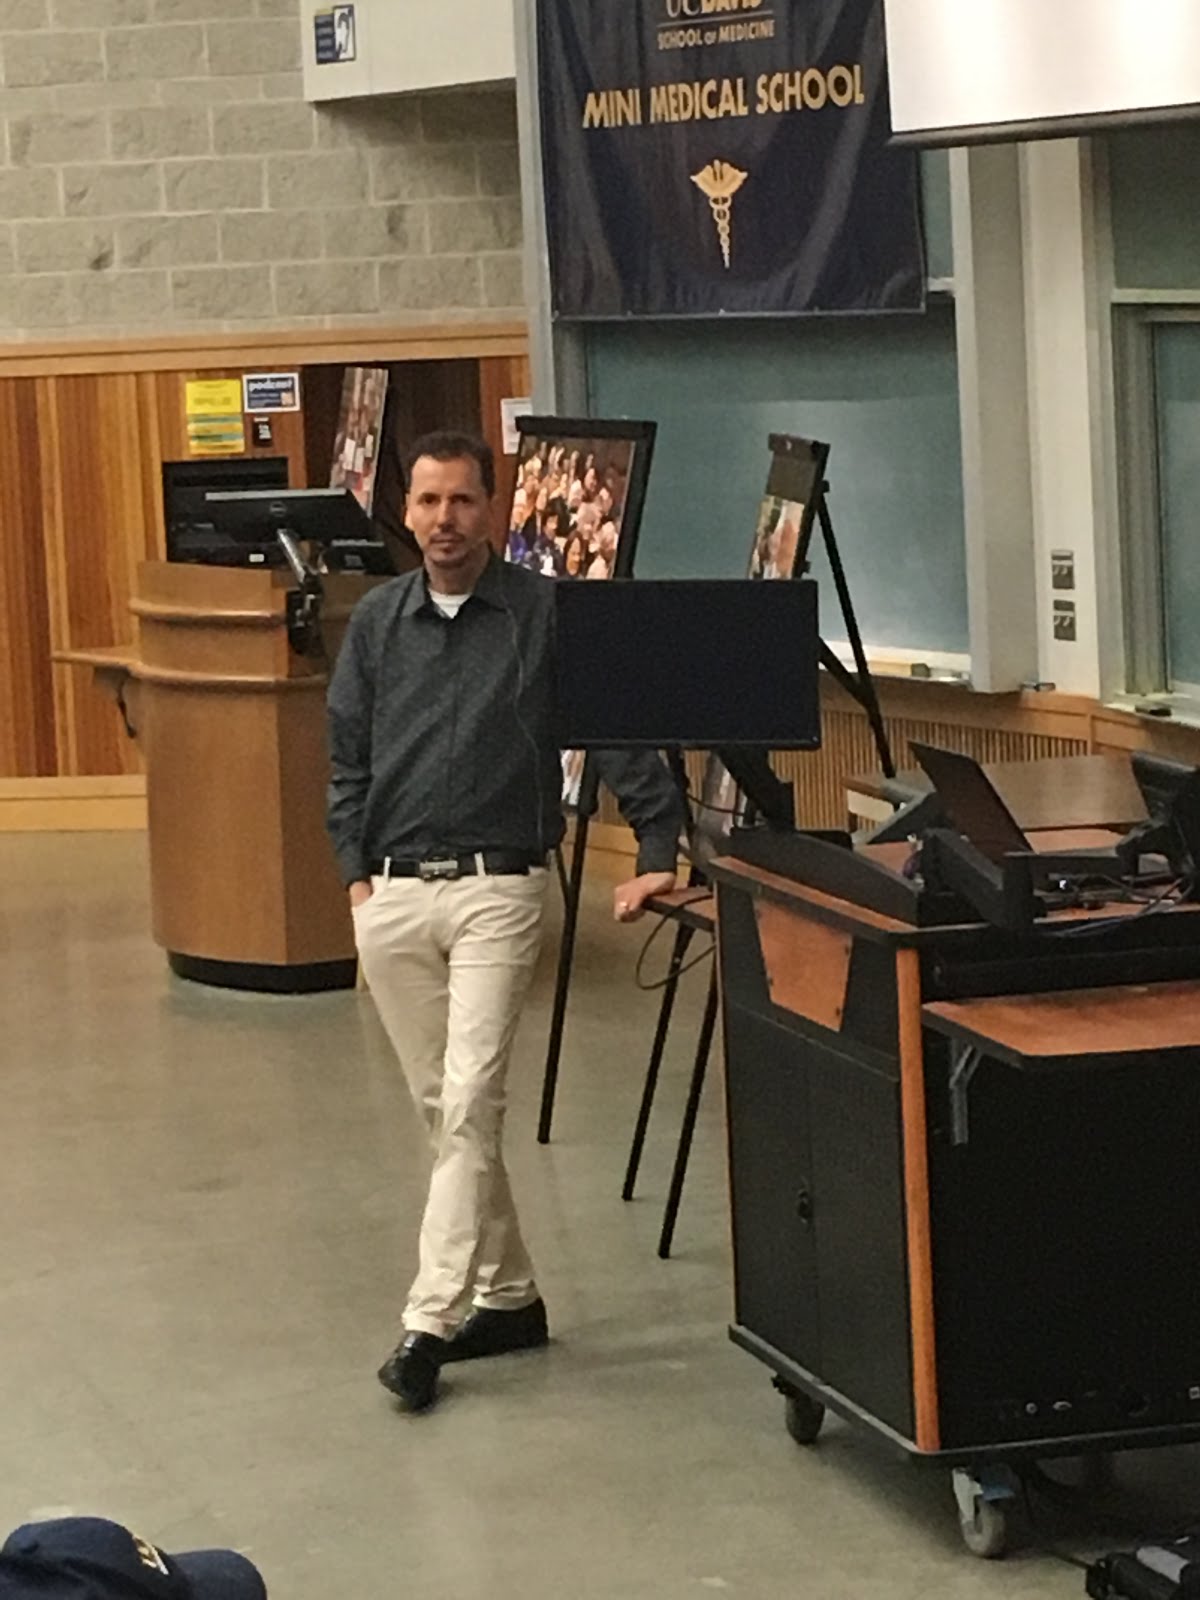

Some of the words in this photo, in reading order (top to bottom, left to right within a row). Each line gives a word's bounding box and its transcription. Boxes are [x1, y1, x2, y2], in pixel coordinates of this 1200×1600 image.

[657, 28, 703, 50] SCHOOL
[718, 19, 775, 43] MEDICINE
[582, 88, 642, 129] MINI
[649, 77, 749, 124] MEDICAL
[755, 64, 865, 115] SCHOOL
